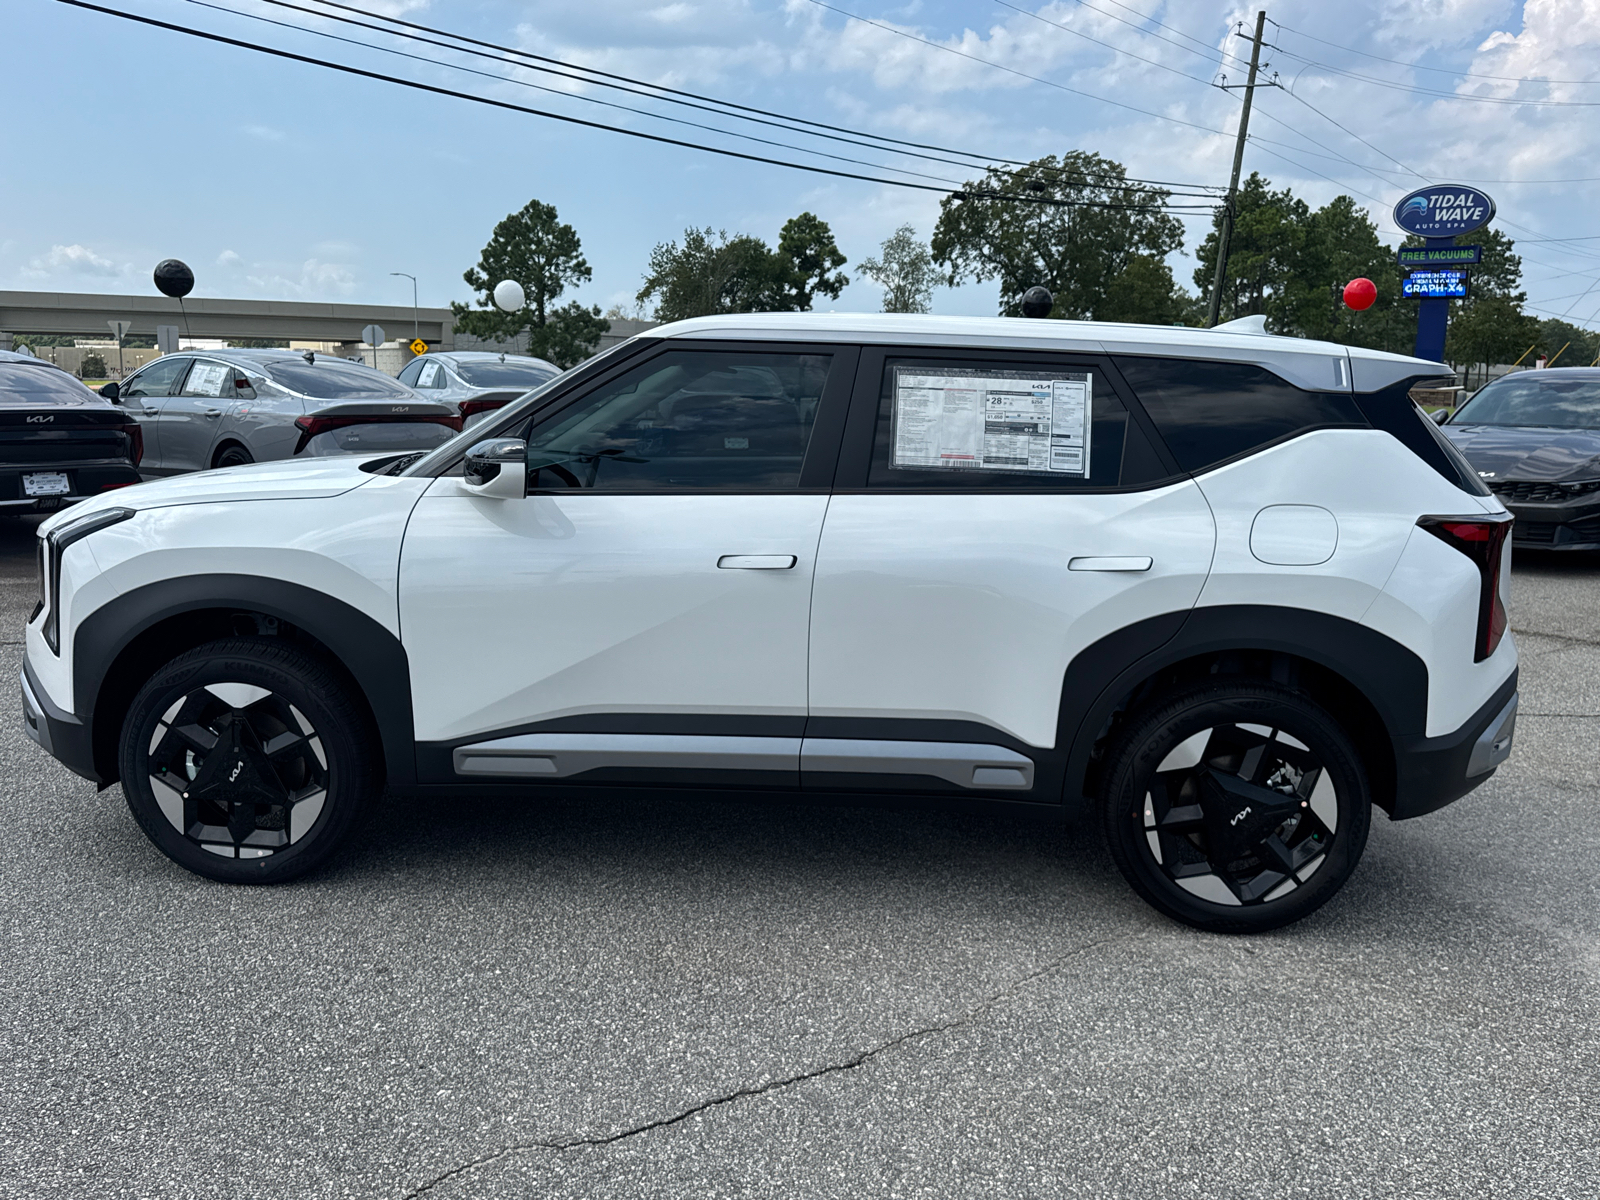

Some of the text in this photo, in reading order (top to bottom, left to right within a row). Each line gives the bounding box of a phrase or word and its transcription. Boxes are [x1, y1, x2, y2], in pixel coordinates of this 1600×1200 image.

[1429, 194, 1474, 208] TIDAL
[1434, 207, 1484, 221] WAVE
[1401, 249, 1475, 261] FREE VACUUMS
[991, 396, 1002, 405] 28
[26, 415, 55, 423] KIA
[224, 661, 288, 686] KUMHO
[1140, 714, 1193, 763] SOLUS
[228, 760, 244, 783] KIA
[1230, 806, 1252, 826] KIA
